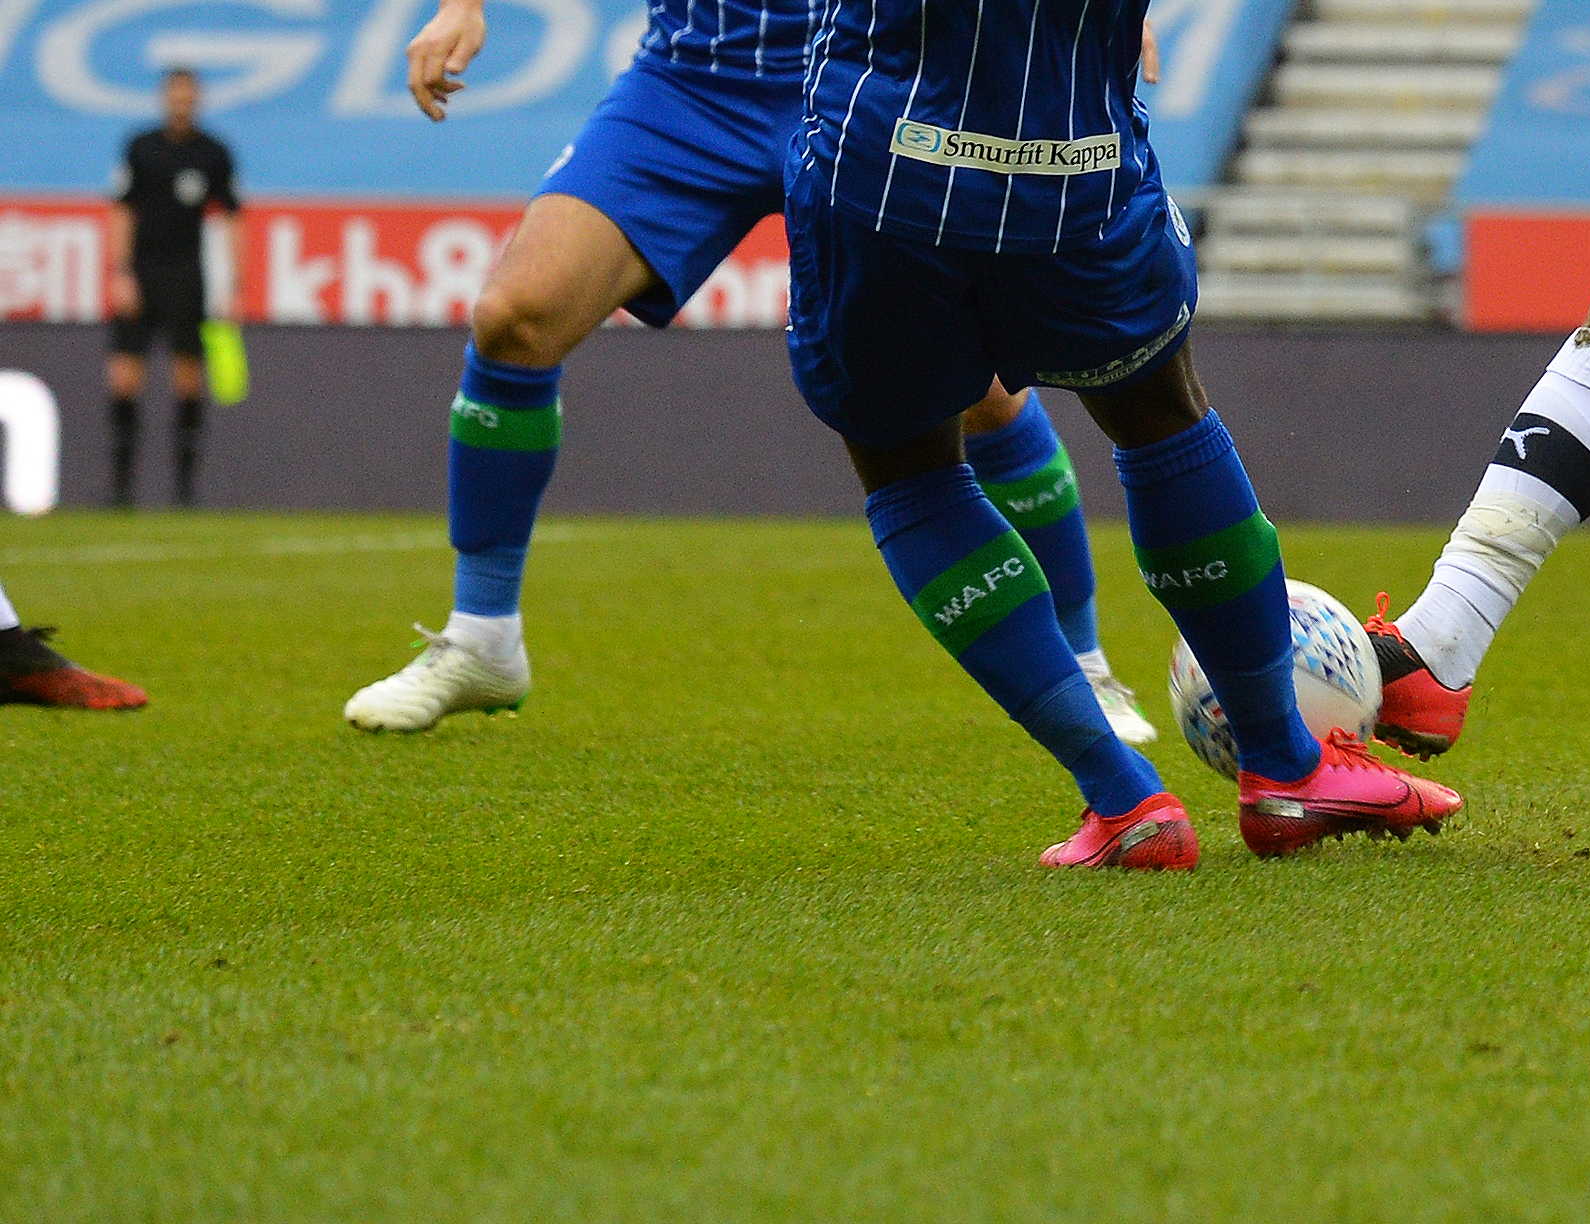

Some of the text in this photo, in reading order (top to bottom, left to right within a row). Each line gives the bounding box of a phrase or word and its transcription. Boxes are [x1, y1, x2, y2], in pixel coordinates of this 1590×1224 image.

[943, 133, 1118, 171] Smurfit Kappa
[933, 557, 1025, 627] WAFC
